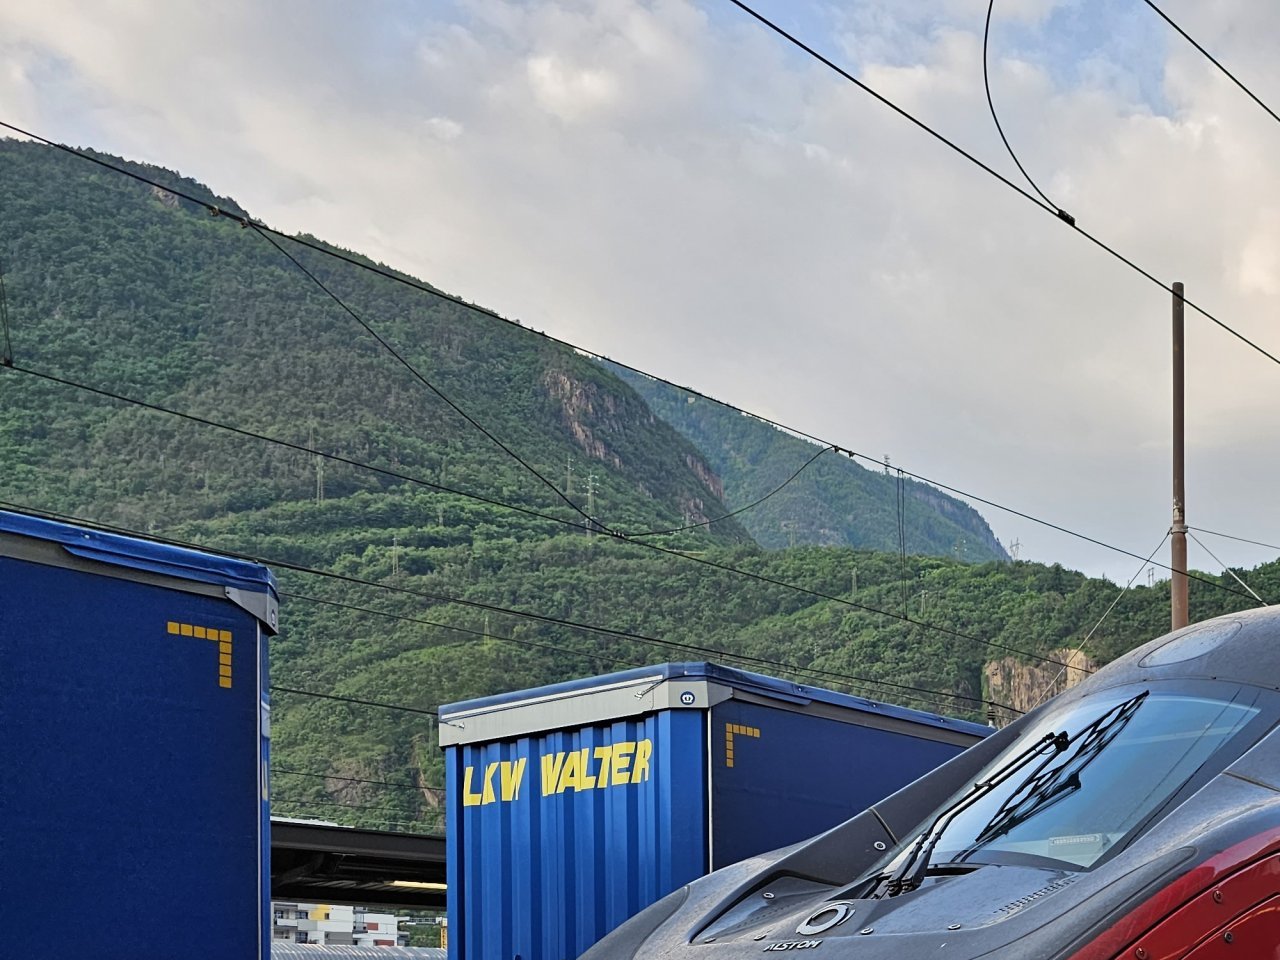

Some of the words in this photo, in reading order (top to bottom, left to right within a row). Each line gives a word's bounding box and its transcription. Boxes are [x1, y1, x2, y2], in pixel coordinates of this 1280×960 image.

[463, 757, 527, 806] LKW
[540, 738, 652, 797] WALTER
[763, 939, 823, 952] ALSTOM
